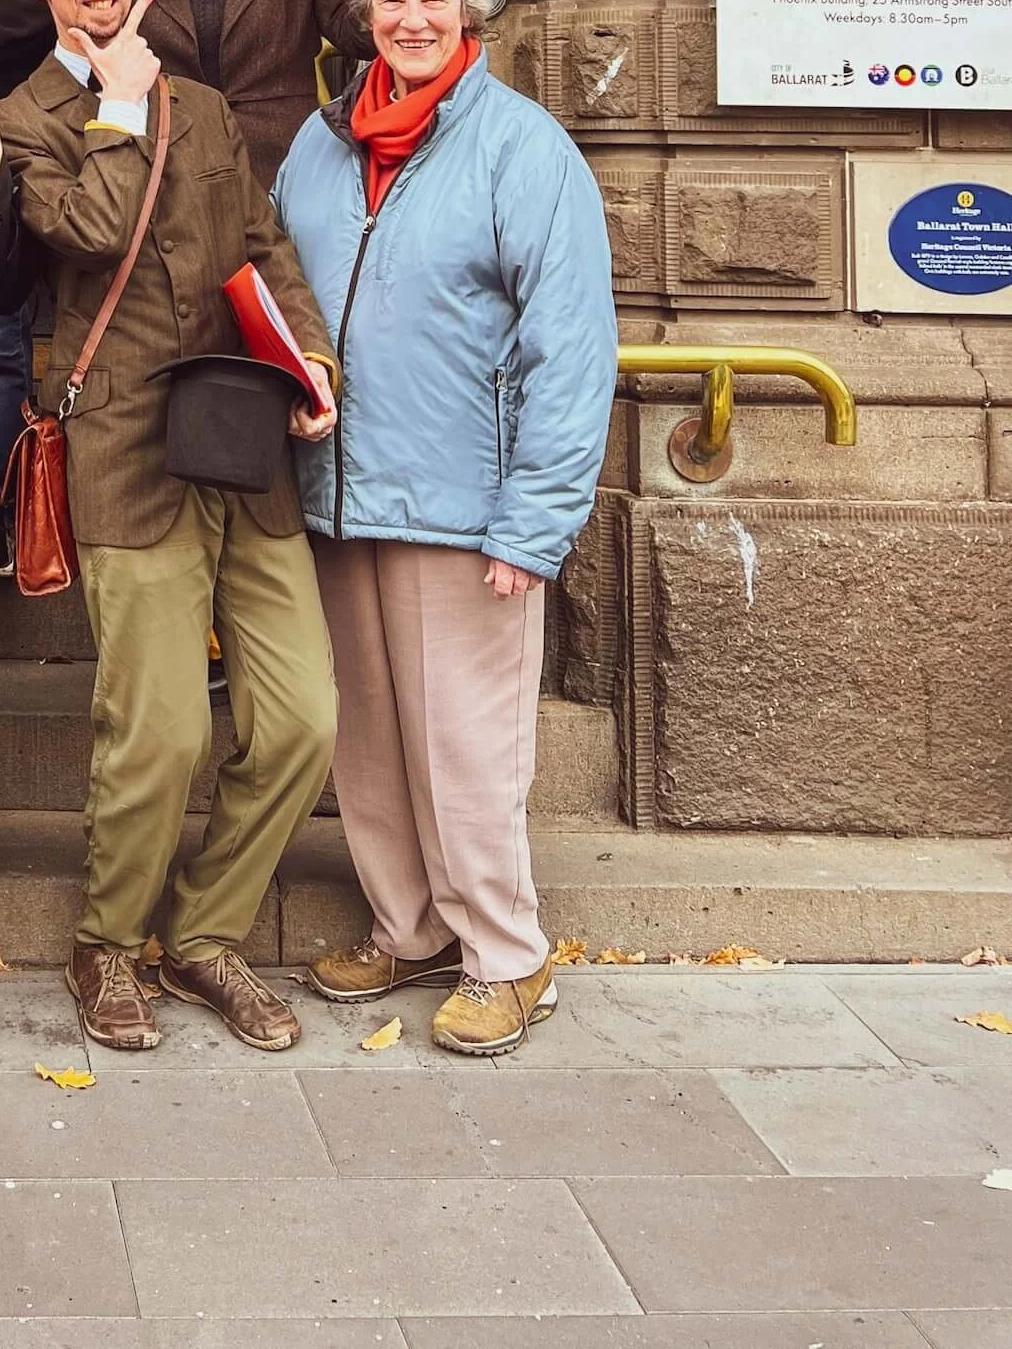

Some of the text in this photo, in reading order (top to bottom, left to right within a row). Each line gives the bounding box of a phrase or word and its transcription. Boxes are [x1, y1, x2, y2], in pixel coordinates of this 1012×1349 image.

[772, 74, 828, 85] BALLARAT
[917, 221, 961, 230] Ballarat
[961, 222, 990, 231] Town
